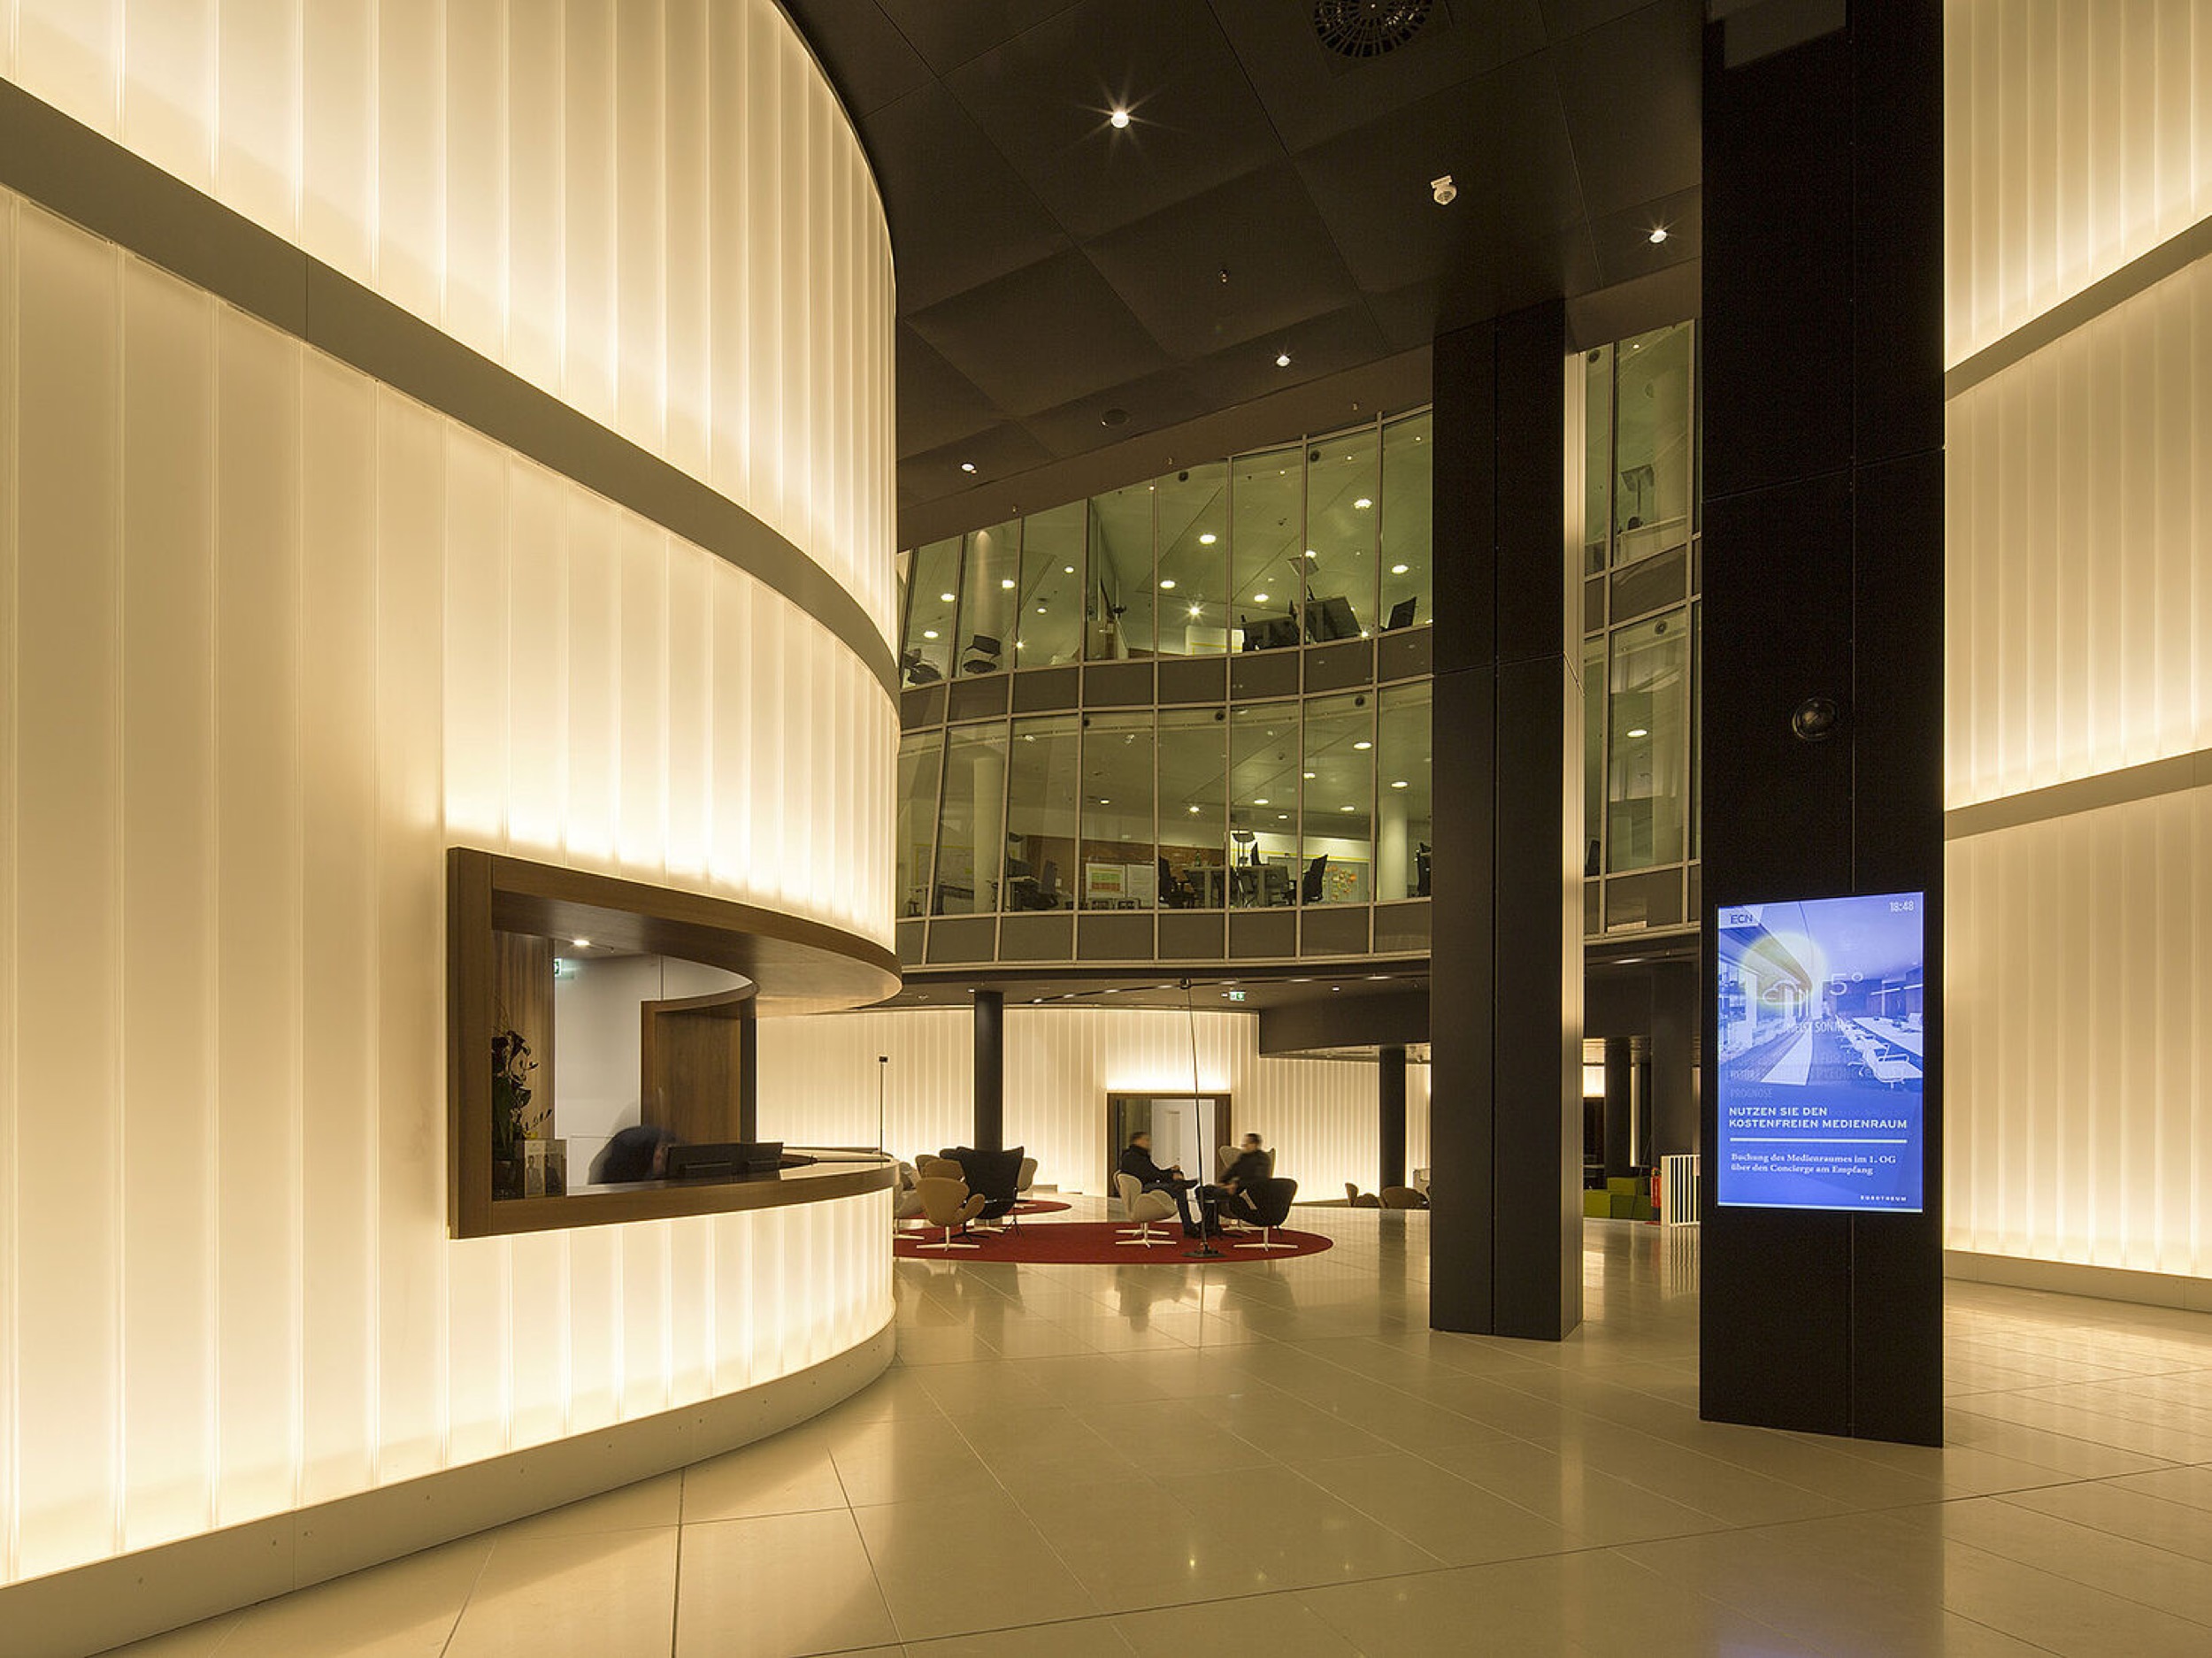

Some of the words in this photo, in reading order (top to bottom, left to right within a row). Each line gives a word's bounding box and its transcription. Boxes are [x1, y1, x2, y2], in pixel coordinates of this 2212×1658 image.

[1730, 914, 1753, 924] ECN
[1729, 1107, 1777, 1117] NUTZEN
[1780, 1107, 1800, 1116] SIE
[1802, 1107, 1828, 1117] DEN
[1729, 1118, 1818, 1128] KOSTENFREIEN
[1822, 1119, 1907, 1129] MEDIENRAUM
[1731, 1153, 1770, 1163] Buchung
[1786, 1154, 1853, 1163] Medienraumes
[1854, 1155, 1868, 1163] im
[1879, 1155, 1896, 1164] OG
[1751, 1163, 1769, 1172] den
[1770, 1164, 1815, 1175] Concierge
[1832, 1165, 1874, 1176] Empfang
